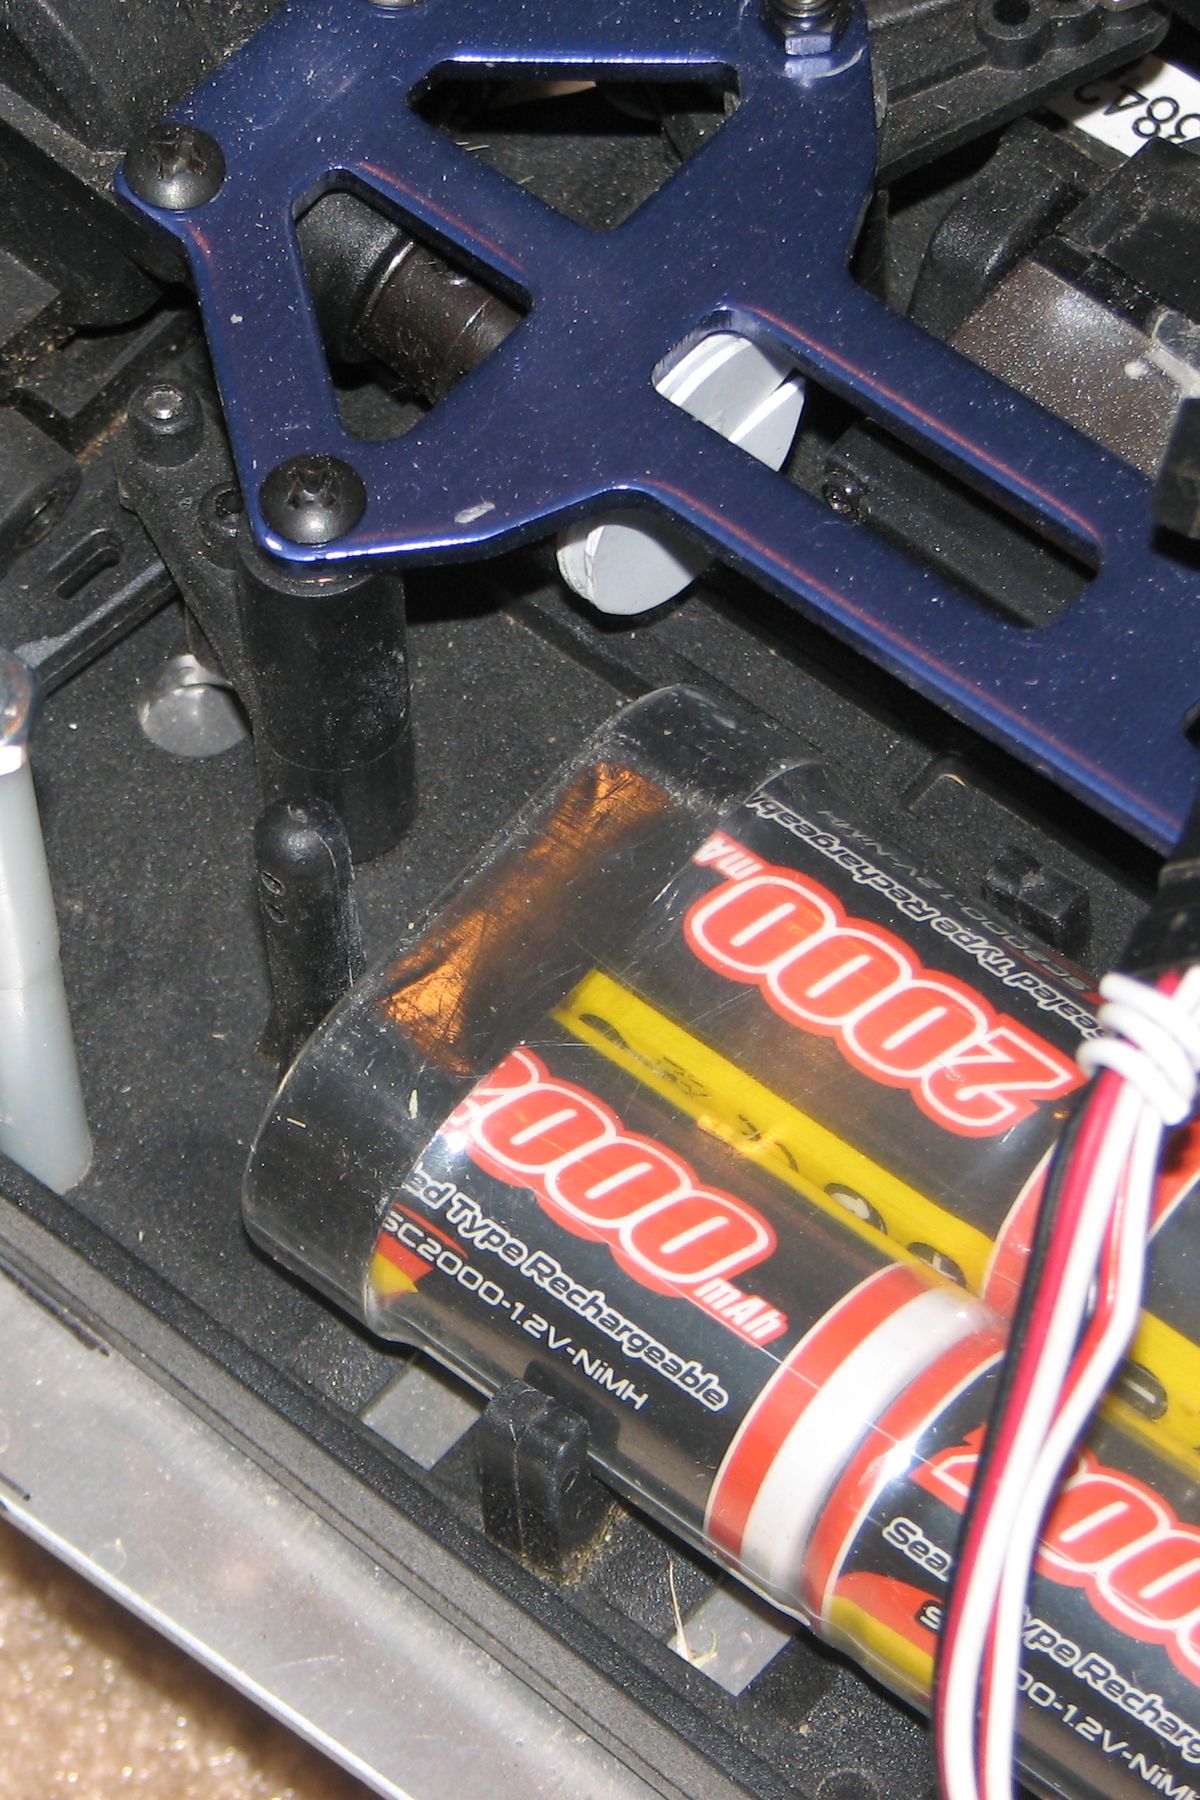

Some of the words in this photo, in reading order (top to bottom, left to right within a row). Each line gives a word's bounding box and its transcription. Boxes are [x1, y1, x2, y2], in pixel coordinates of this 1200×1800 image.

[745, 791, 942, 922] Rechargeabl
[684, 865, 1084, 1135] 2000
[930, 916, 1017, 978] Type
[445, 1192, 529, 1268] Type
[519, 1250, 730, 1413] Rechargeable
[692, 1277, 788, 1341] mAh
